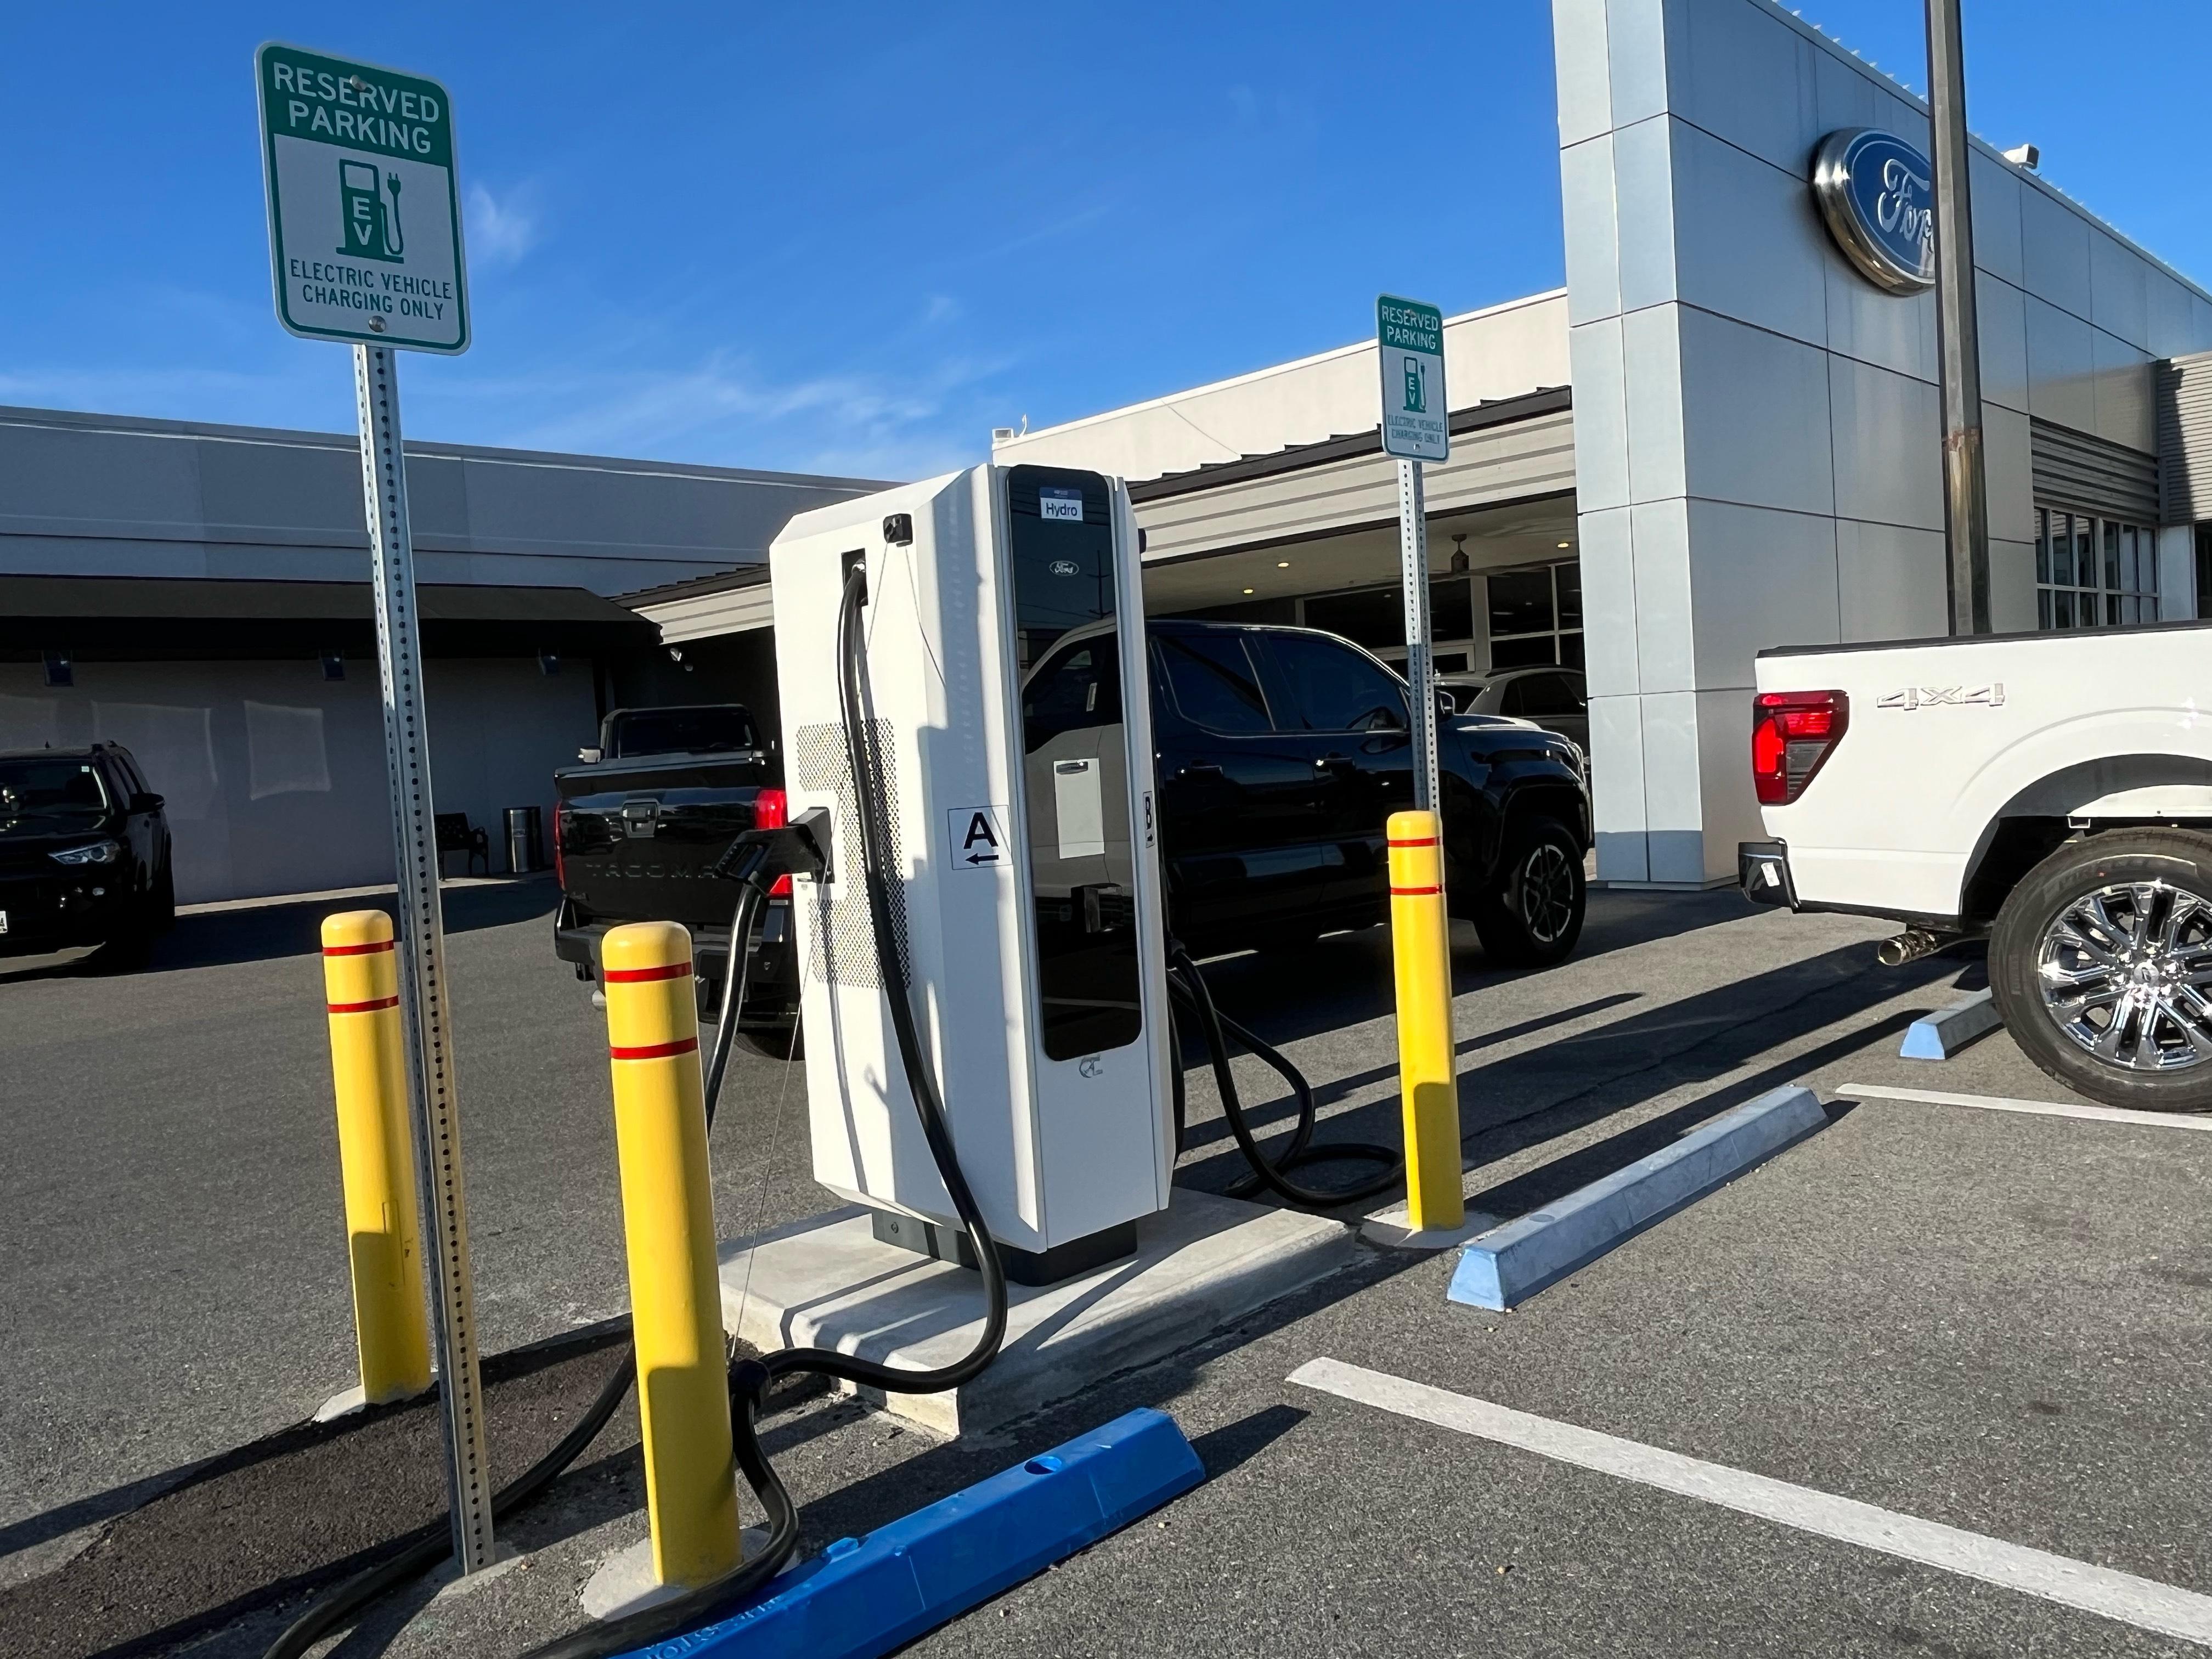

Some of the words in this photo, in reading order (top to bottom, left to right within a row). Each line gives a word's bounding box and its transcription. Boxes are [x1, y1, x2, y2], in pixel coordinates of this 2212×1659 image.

[274, 62, 439, 122] RESERVED
[289, 99, 431, 154] PARKING
[290, 258, 374, 288] ELECTRIC
[381, 272, 452, 300] VEHICLE
[302, 284, 393, 313] CHARGING
[400, 298, 443, 320] ONLY
[1381, 305, 1438, 331] RESERVED
[1386, 325, 1436, 350] PARKING
[1046, 502, 1077, 517] Hydro
[1876, 682, 2005, 711] 4X4
[963, 812, 998, 849] A
